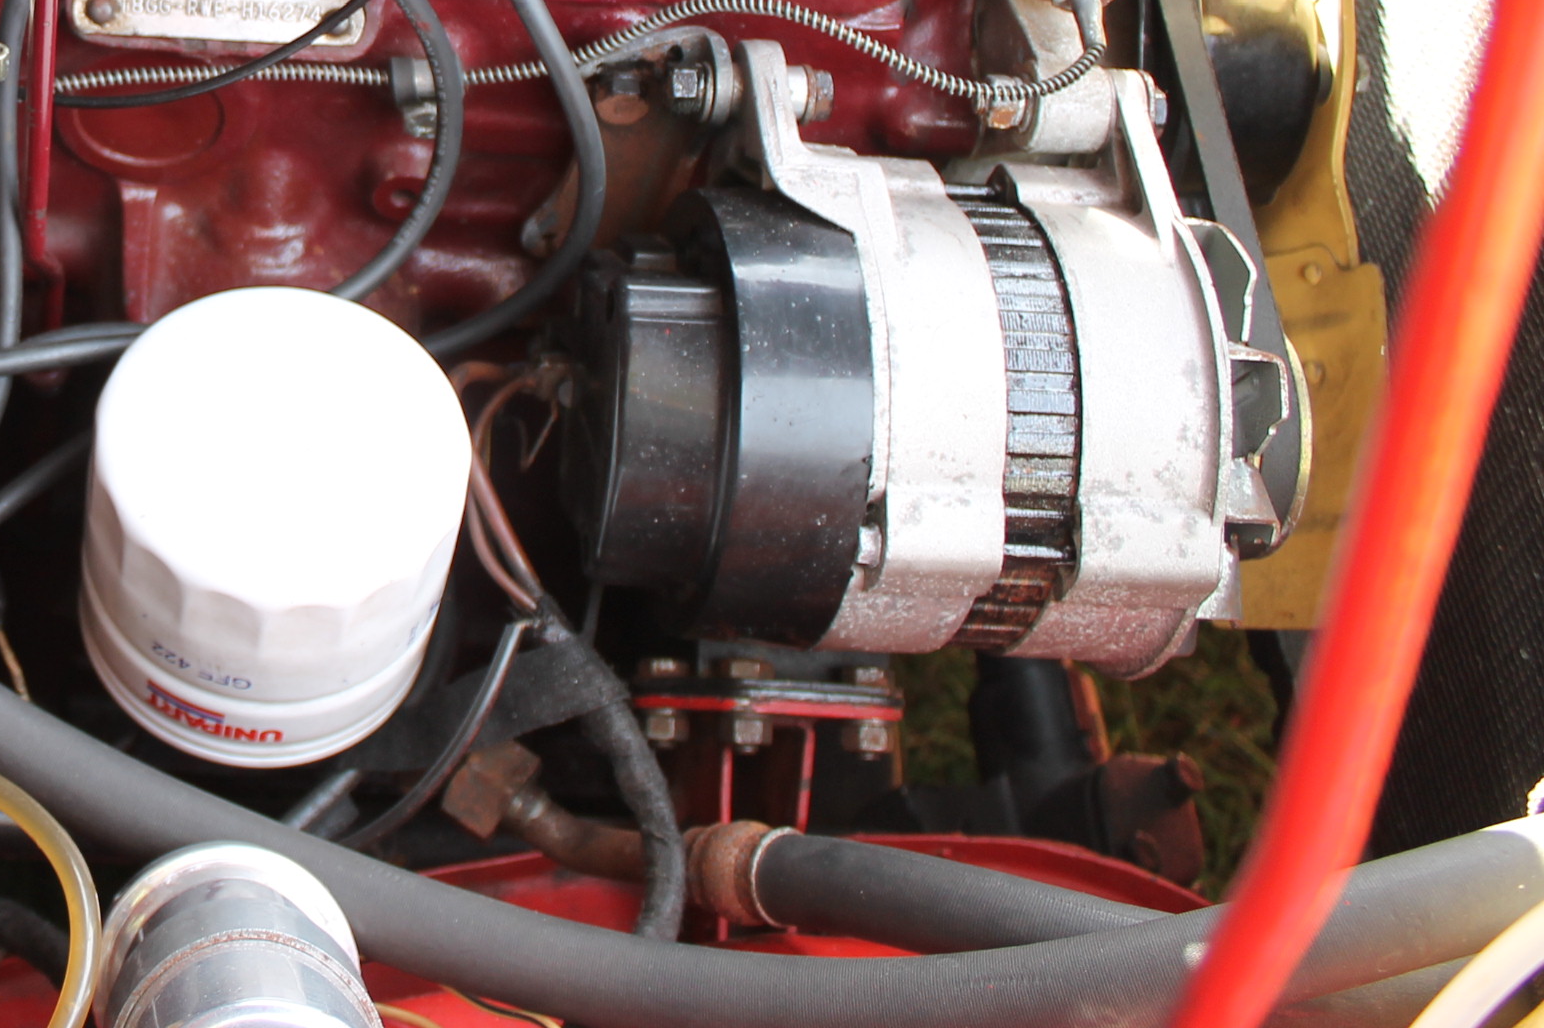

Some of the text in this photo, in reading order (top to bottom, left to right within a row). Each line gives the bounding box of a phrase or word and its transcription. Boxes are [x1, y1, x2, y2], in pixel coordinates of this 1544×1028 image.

[152, 641, 252, 690] GFE 422
[146, 692, 284, 743] UNIPART
